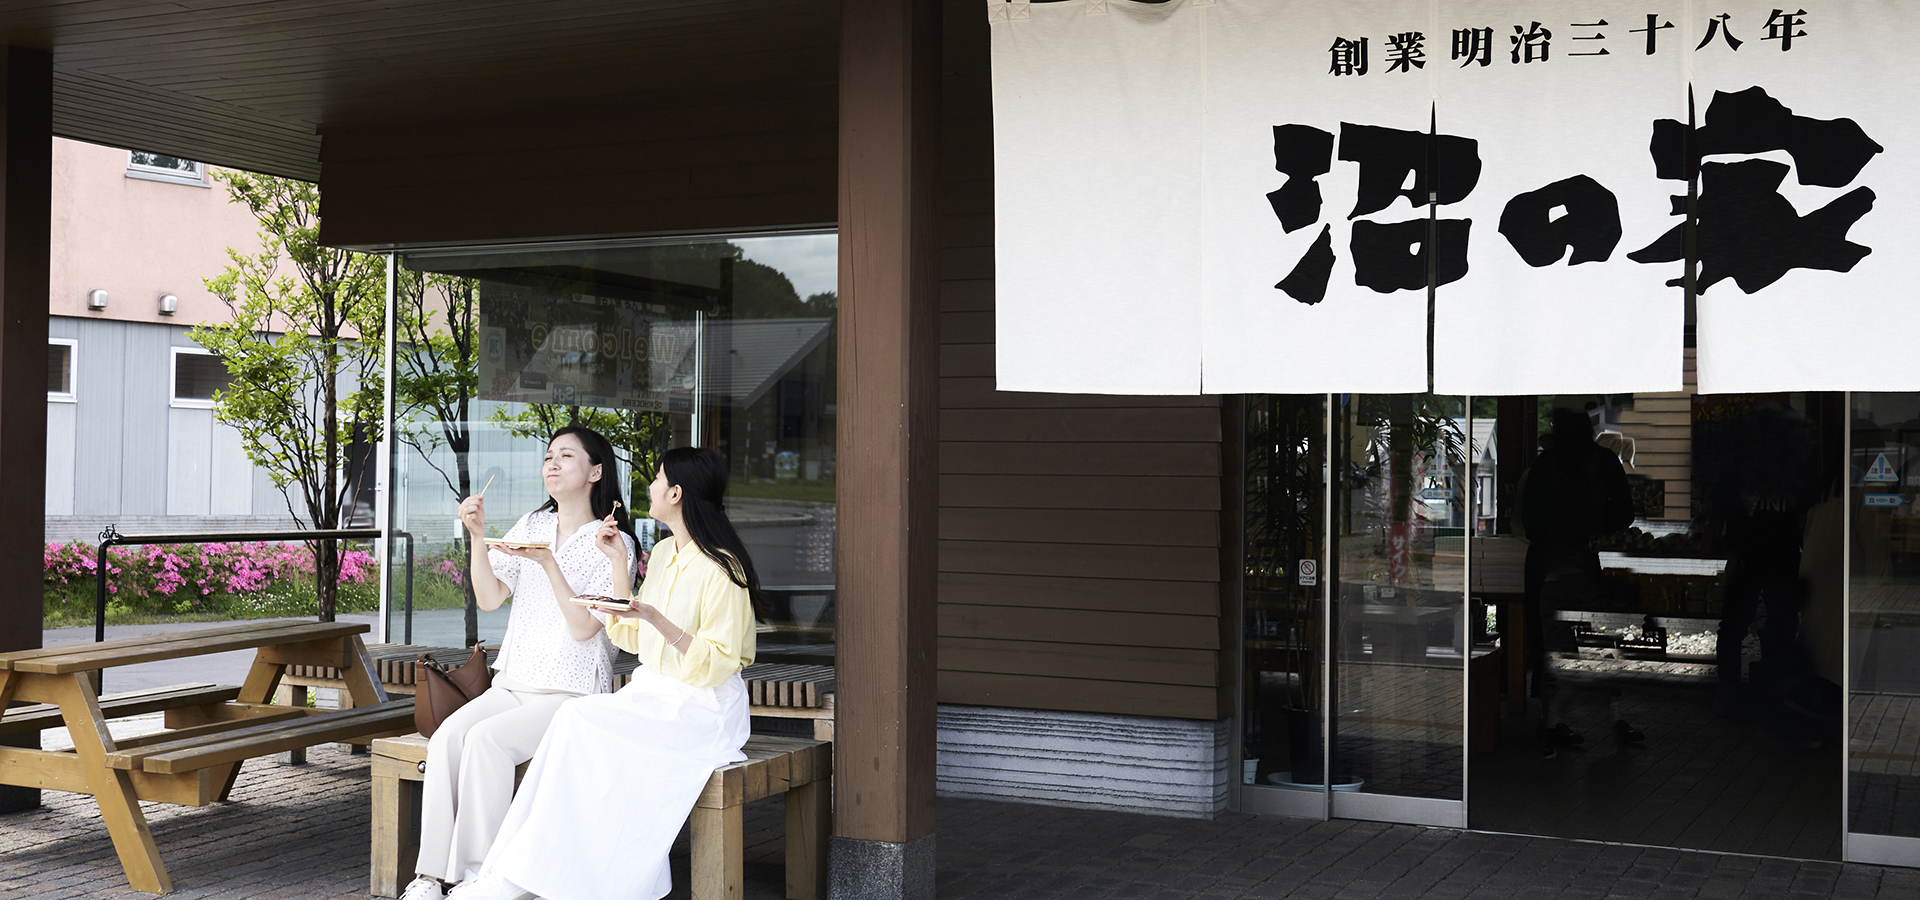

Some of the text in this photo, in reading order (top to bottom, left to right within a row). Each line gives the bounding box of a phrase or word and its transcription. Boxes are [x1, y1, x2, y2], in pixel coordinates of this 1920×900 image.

[1328, 8, 1808, 77] 創業明治三十八年
[1265, 86, 1884, 306] 沼の家
[1871, 467, 1892, 475] 注意
